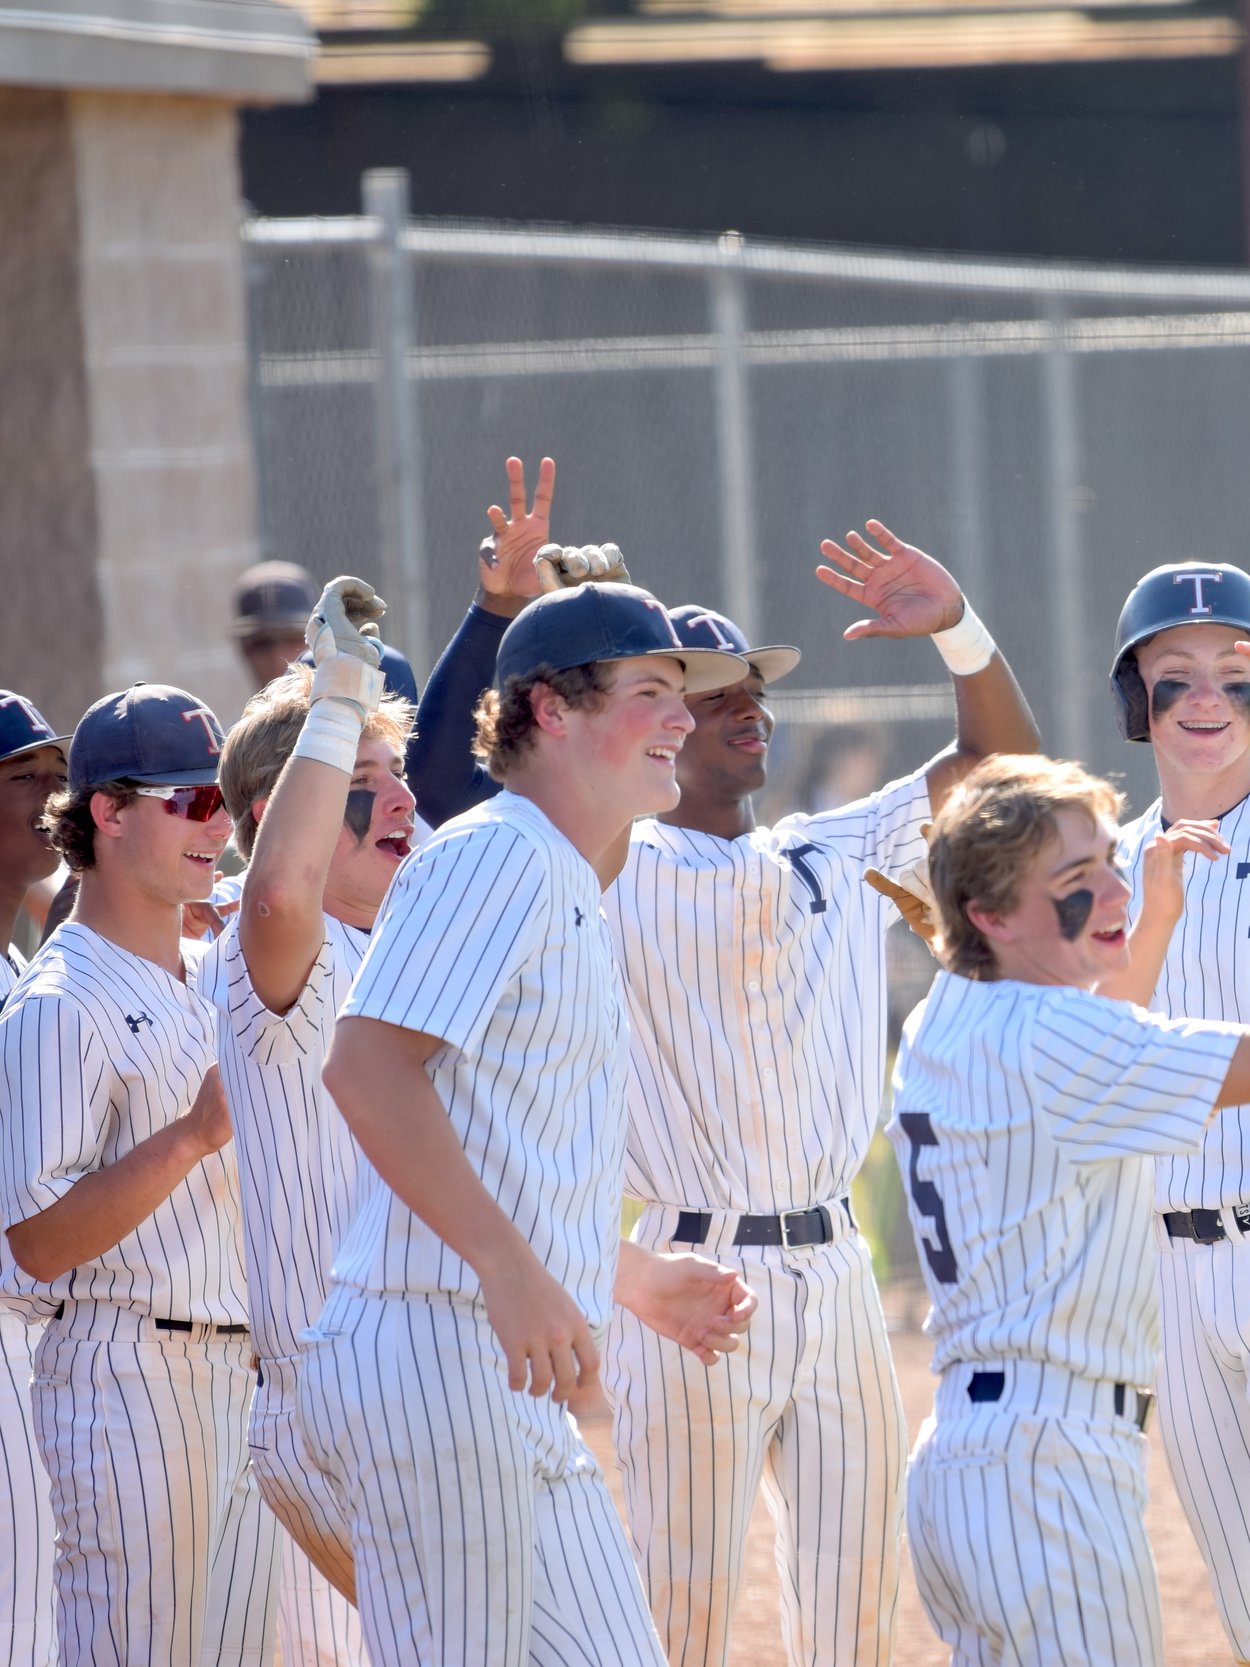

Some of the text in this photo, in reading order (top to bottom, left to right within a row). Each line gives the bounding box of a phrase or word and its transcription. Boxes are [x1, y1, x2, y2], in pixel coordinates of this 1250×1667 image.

[1173, 572, 1223, 615] T
[686, 613, 735, 650] T
[181, 708, 223, 755] T
[780, 843, 826, 914] T
[899, 1112, 959, 1284] 5
